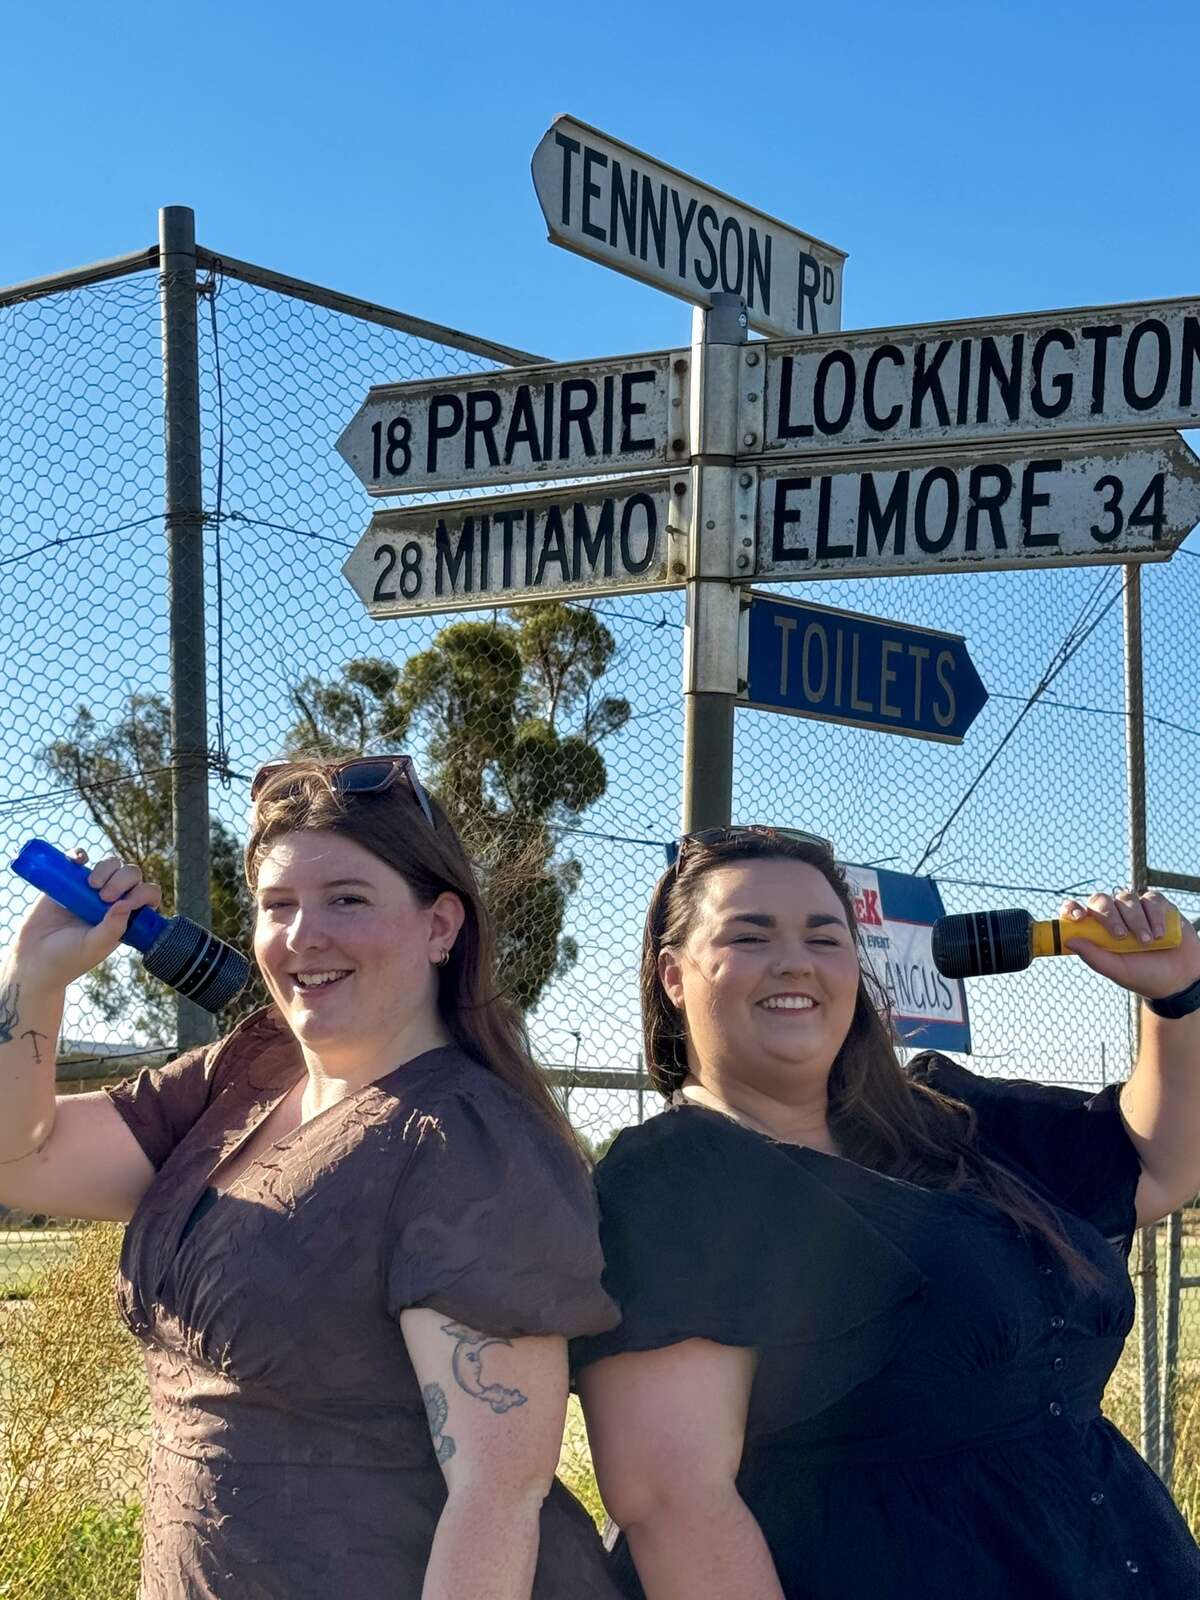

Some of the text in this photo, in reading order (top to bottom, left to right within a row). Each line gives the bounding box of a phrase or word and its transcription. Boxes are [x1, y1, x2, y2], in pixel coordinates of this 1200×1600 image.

[555, 132, 834, 335] TENNYSON RD
[371, 370, 656, 478] 18 PRAIRIE
[372, 492, 657, 602] 28 MITIAMO
[772, 459, 1169, 562] ELMORE 34
[773, 616, 957, 728] TOILETS
[867, 935, 890, 950] EVENT
